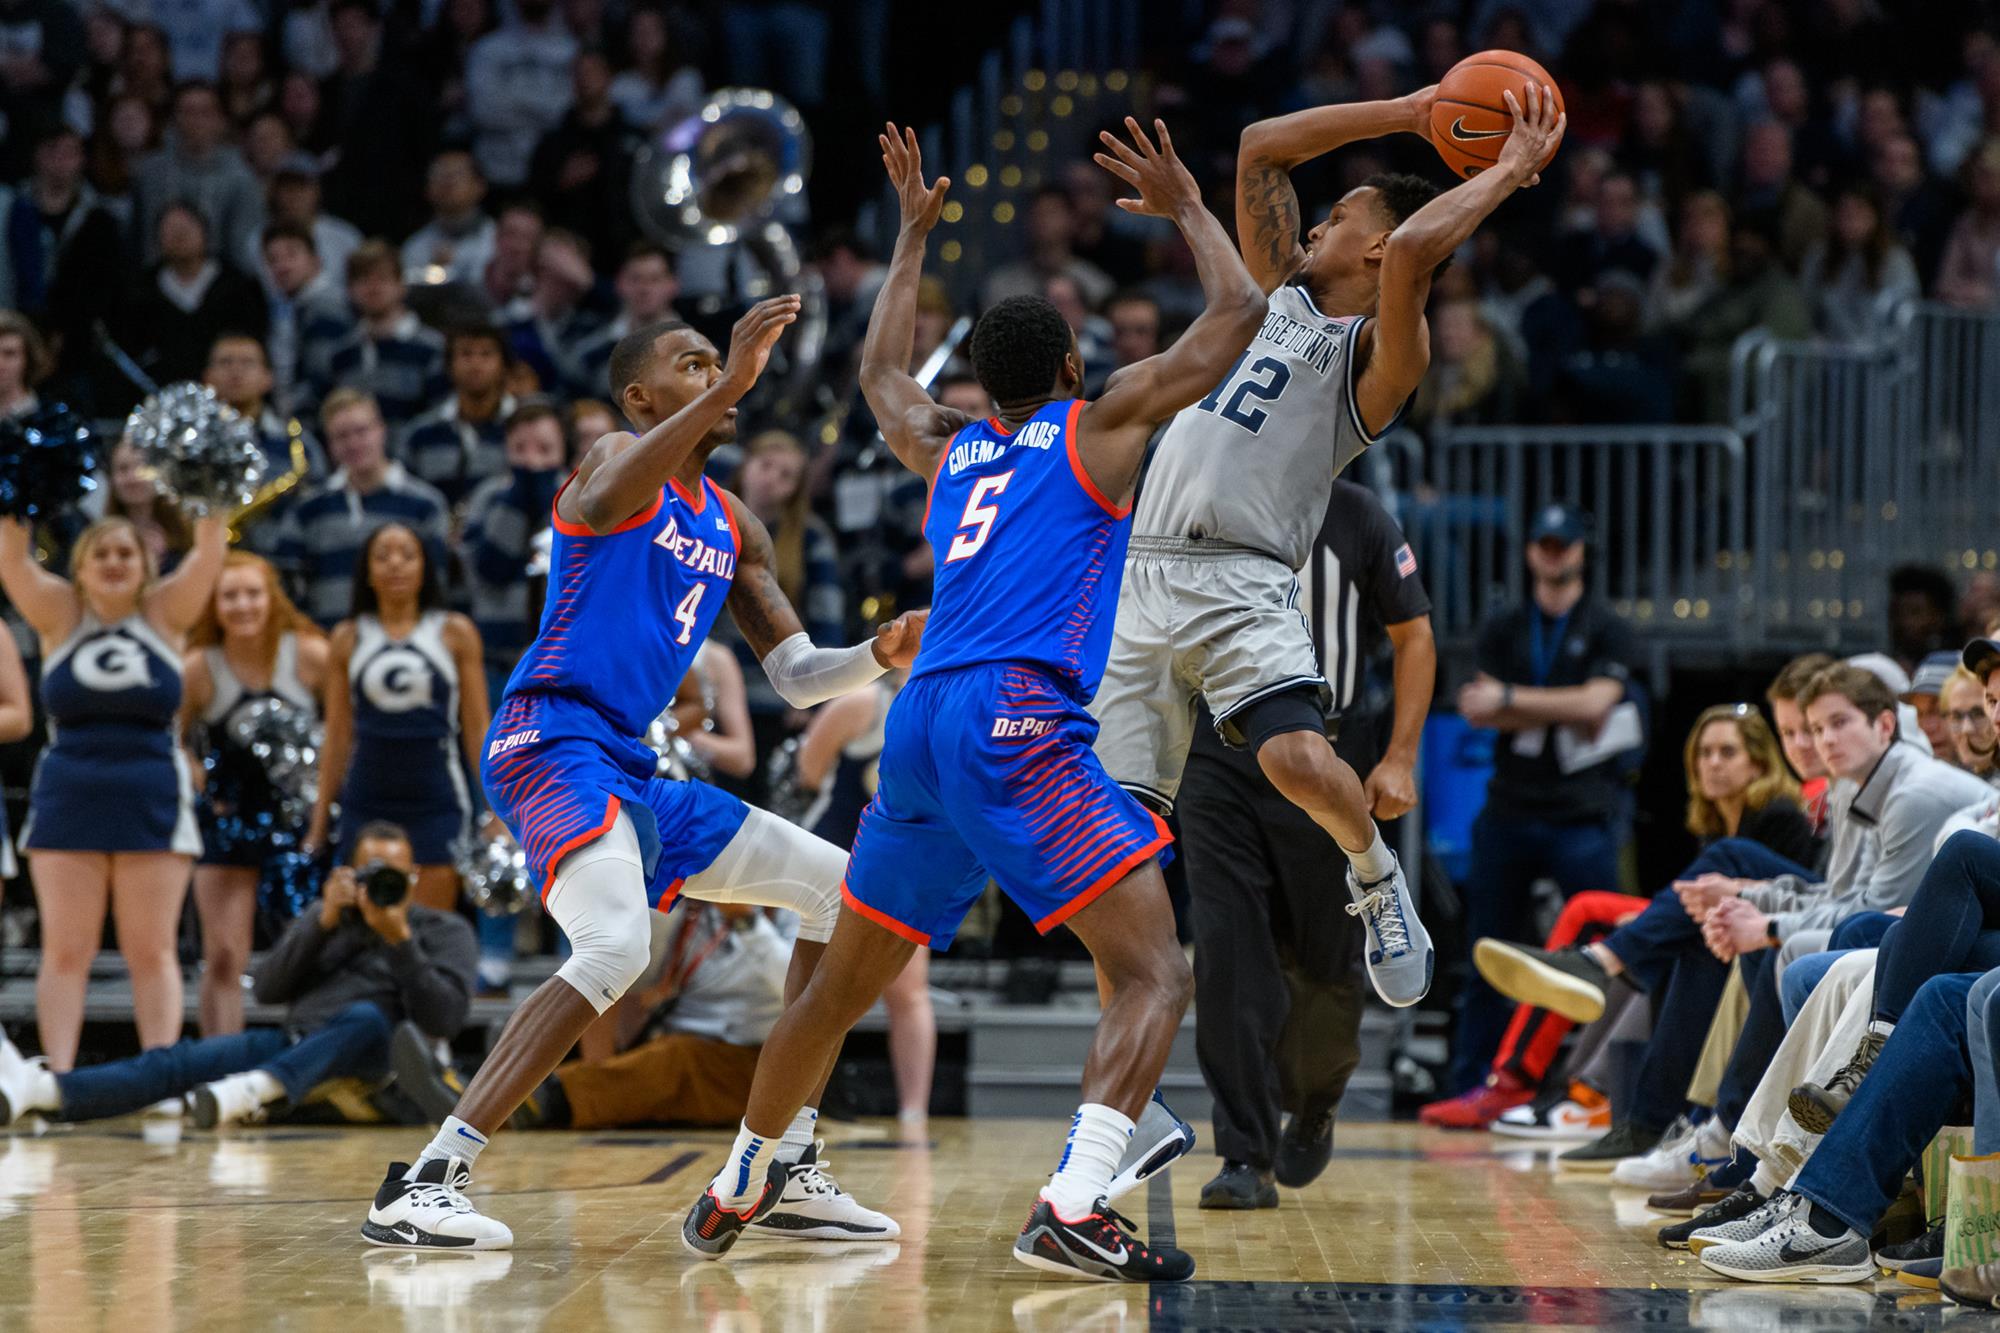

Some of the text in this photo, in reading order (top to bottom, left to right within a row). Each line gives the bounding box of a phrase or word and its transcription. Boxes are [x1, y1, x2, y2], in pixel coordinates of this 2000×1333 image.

[1257, 311, 1340, 376] RGETOWN
[1196, 349, 1293, 437] 12
[943, 467, 1017, 564] 5
[674, 581, 707, 645] 4
[72, 635, 152, 692] G
[362, 648, 435, 712] G
